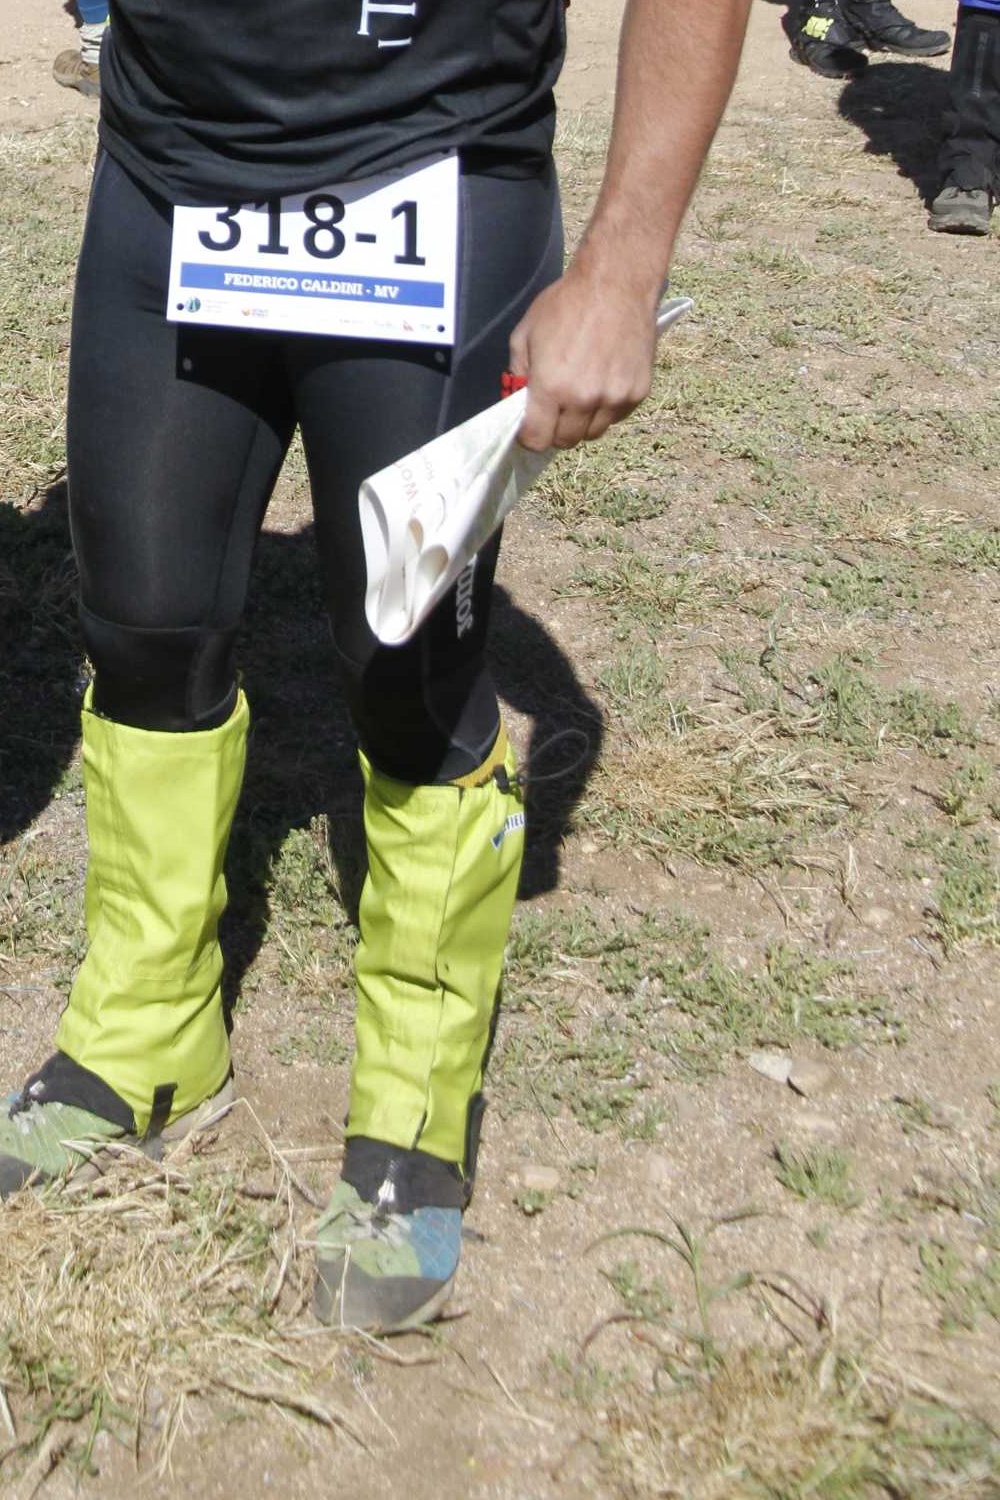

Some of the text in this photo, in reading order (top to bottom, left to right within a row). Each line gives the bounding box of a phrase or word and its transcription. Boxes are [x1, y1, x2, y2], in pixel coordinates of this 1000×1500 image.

[198, 194, 427, 266] 318-1
[223, 272, 298, 291] FEDERICO
[301, 278, 363, 296] CALDINI
[374, 284, 399, 299] MV
